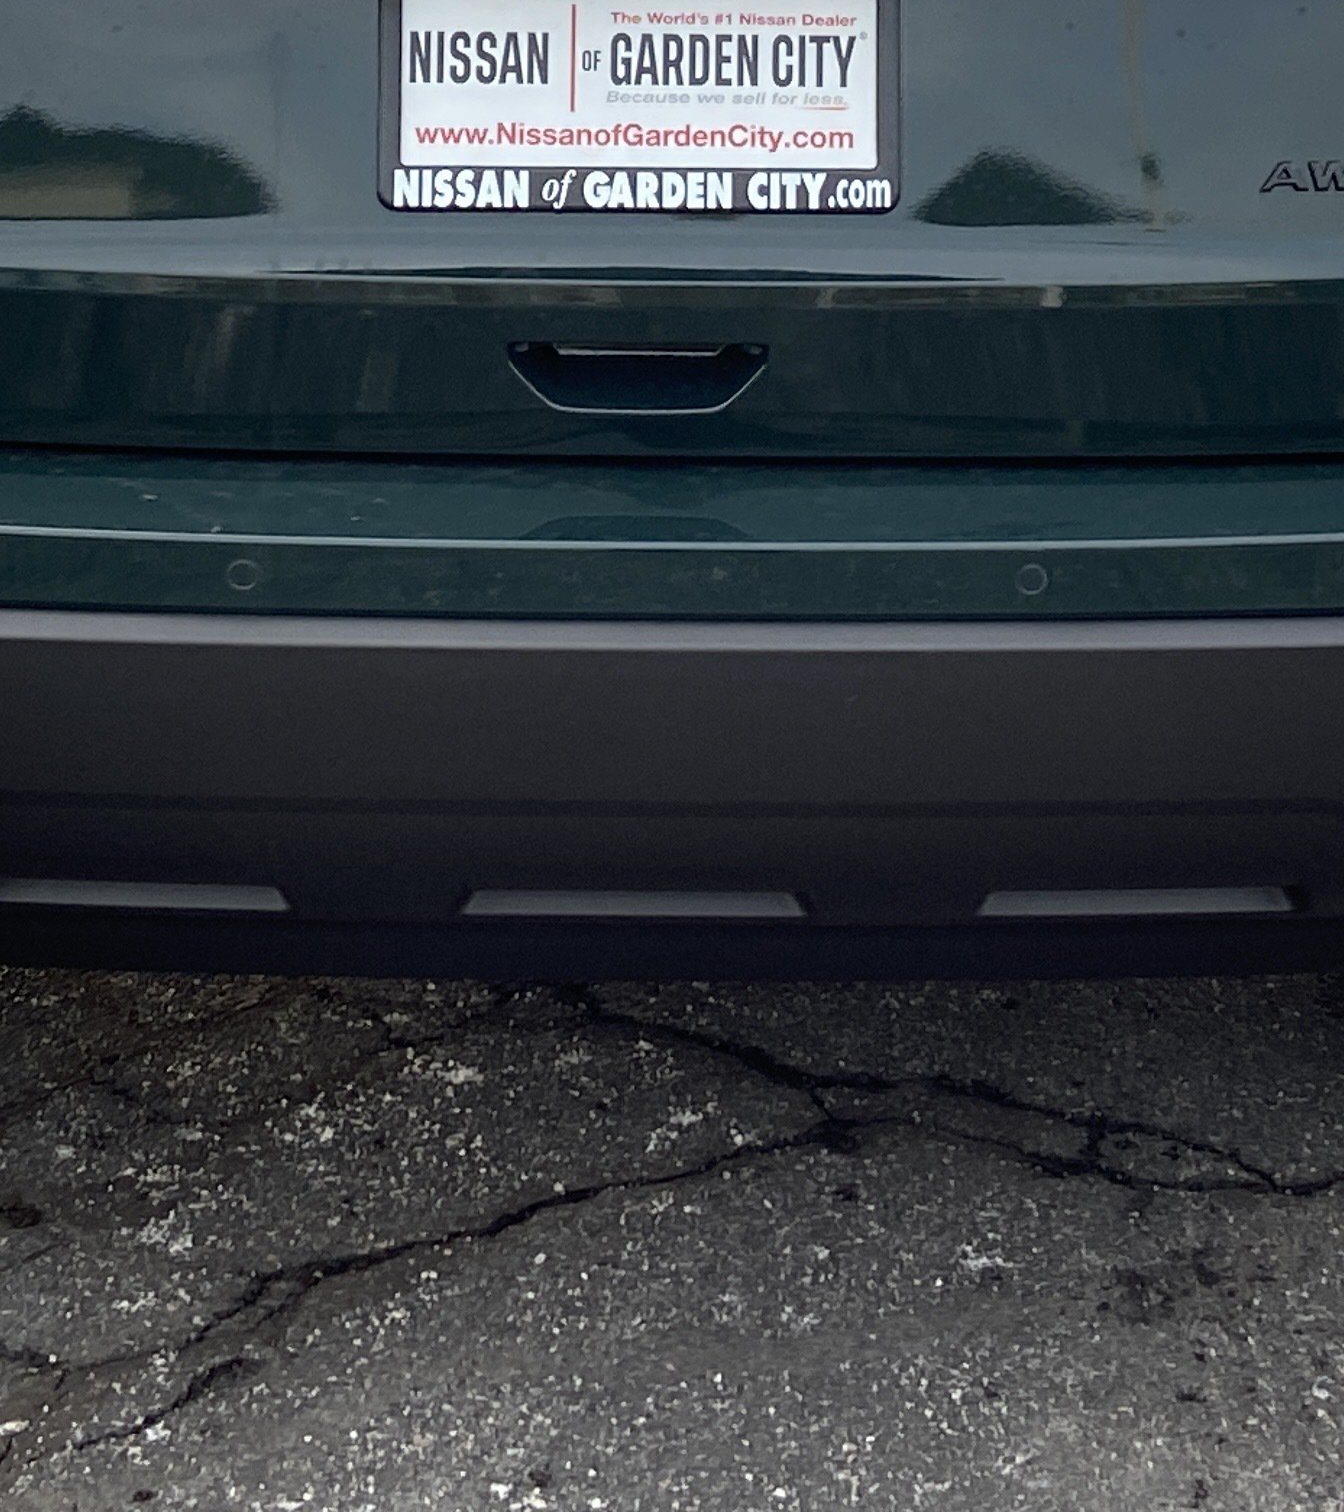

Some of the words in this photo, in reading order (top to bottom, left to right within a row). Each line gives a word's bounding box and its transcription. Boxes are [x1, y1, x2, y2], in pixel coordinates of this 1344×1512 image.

[610, 11, 641, 25] The
[647, 12, 709, 26] World's
[714, 12, 733, 26] #1
[739, 12, 796, 26] Nissan
[801, 14, 857, 27] Dealer
[408, 30, 550, 85] NISSAN
[581, 50, 602, 72] OF
[610, 32, 759, 87] GARDEN
[771, 33, 857, 88] CITY
[606, 90, 691, 104] Because
[697, 93, 726, 104] we
[731, 91, 766, 105] sell
[771, 91, 798, 105] for
[415, 122, 854, 153] www.NissanofGardenCity.com
[392, 168, 530, 209] NISSAN
[541, 169, 578, 210] of
[583, 170, 734, 210] GARDEN
[746, 171, 892, 210] CITY.com
